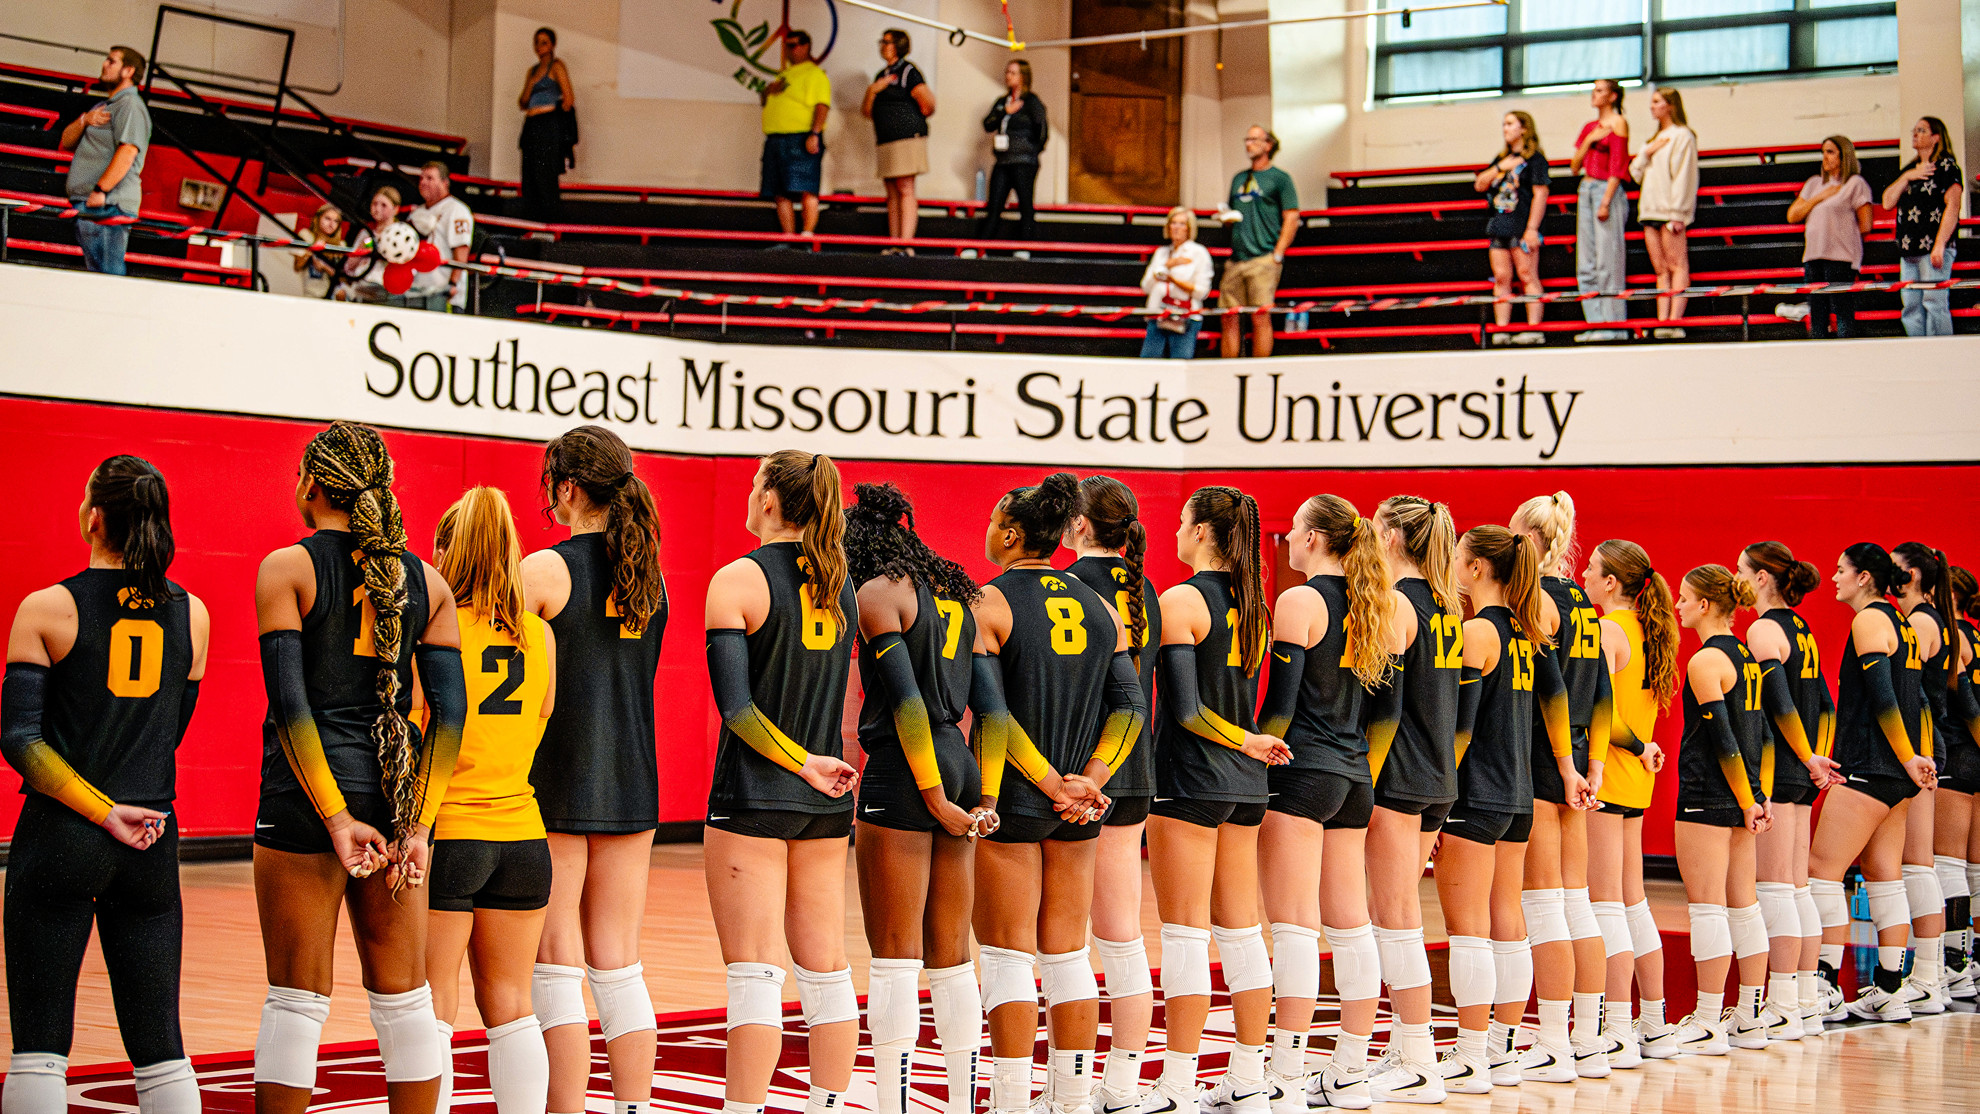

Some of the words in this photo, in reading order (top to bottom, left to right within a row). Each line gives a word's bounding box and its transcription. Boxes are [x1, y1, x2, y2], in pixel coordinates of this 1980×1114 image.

[366, 321, 658, 426] Southeast
[681, 358, 977, 437] Missouri
[1017, 372, 1210, 445] State
[1237, 374, 1580, 460] University
[799, 582, 837, 651] 6
[932, 594, 964, 660] 7
[1044, 597, 1088, 656] 8
[1429, 613, 1464, 669] 12
[1569, 606, 1601, 659] 15
[107, 617, 164, 698] 0
[478, 645, 525, 715] 2
[1508, 637, 1535, 692] 13
[1796, 632, 1820, 679] 21
[1743, 662, 1763, 711] 17
